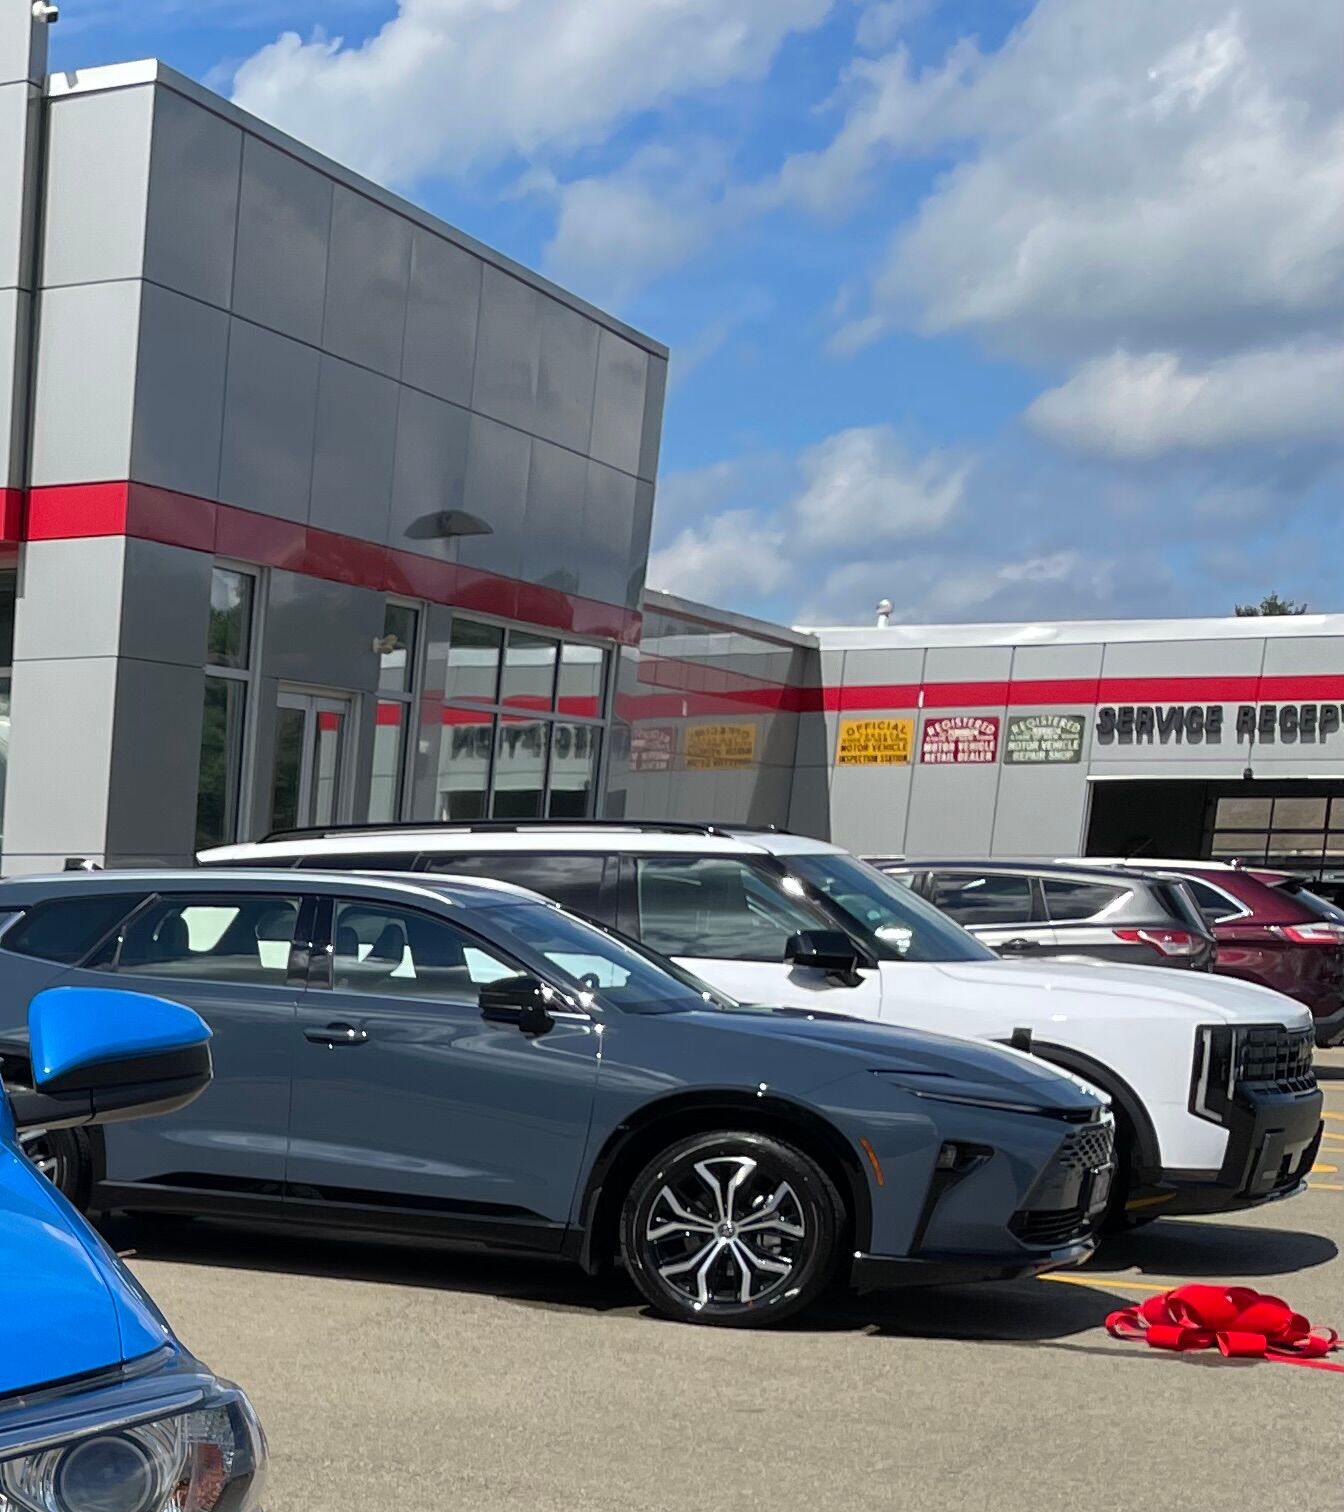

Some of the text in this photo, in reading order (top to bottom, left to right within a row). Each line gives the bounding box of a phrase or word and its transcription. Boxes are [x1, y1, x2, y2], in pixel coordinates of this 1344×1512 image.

[926, 717, 996, 736] REGISTERED
[1011, 716, 1081, 734] REGISTERED
[1096, 704, 1344, 738] SERVICE RECEP
[846, 720, 907, 736] OFFICIAL
[840, 742, 907, 753] MOTOR VEHICLE
[923, 741, 995, 752] MOTOR VEHICLE
[1007, 740, 1080, 751] MOTOR VEHICLE
[957, 751, 992, 761] DEALER
[1012, 750, 1046, 761] REPAIR
